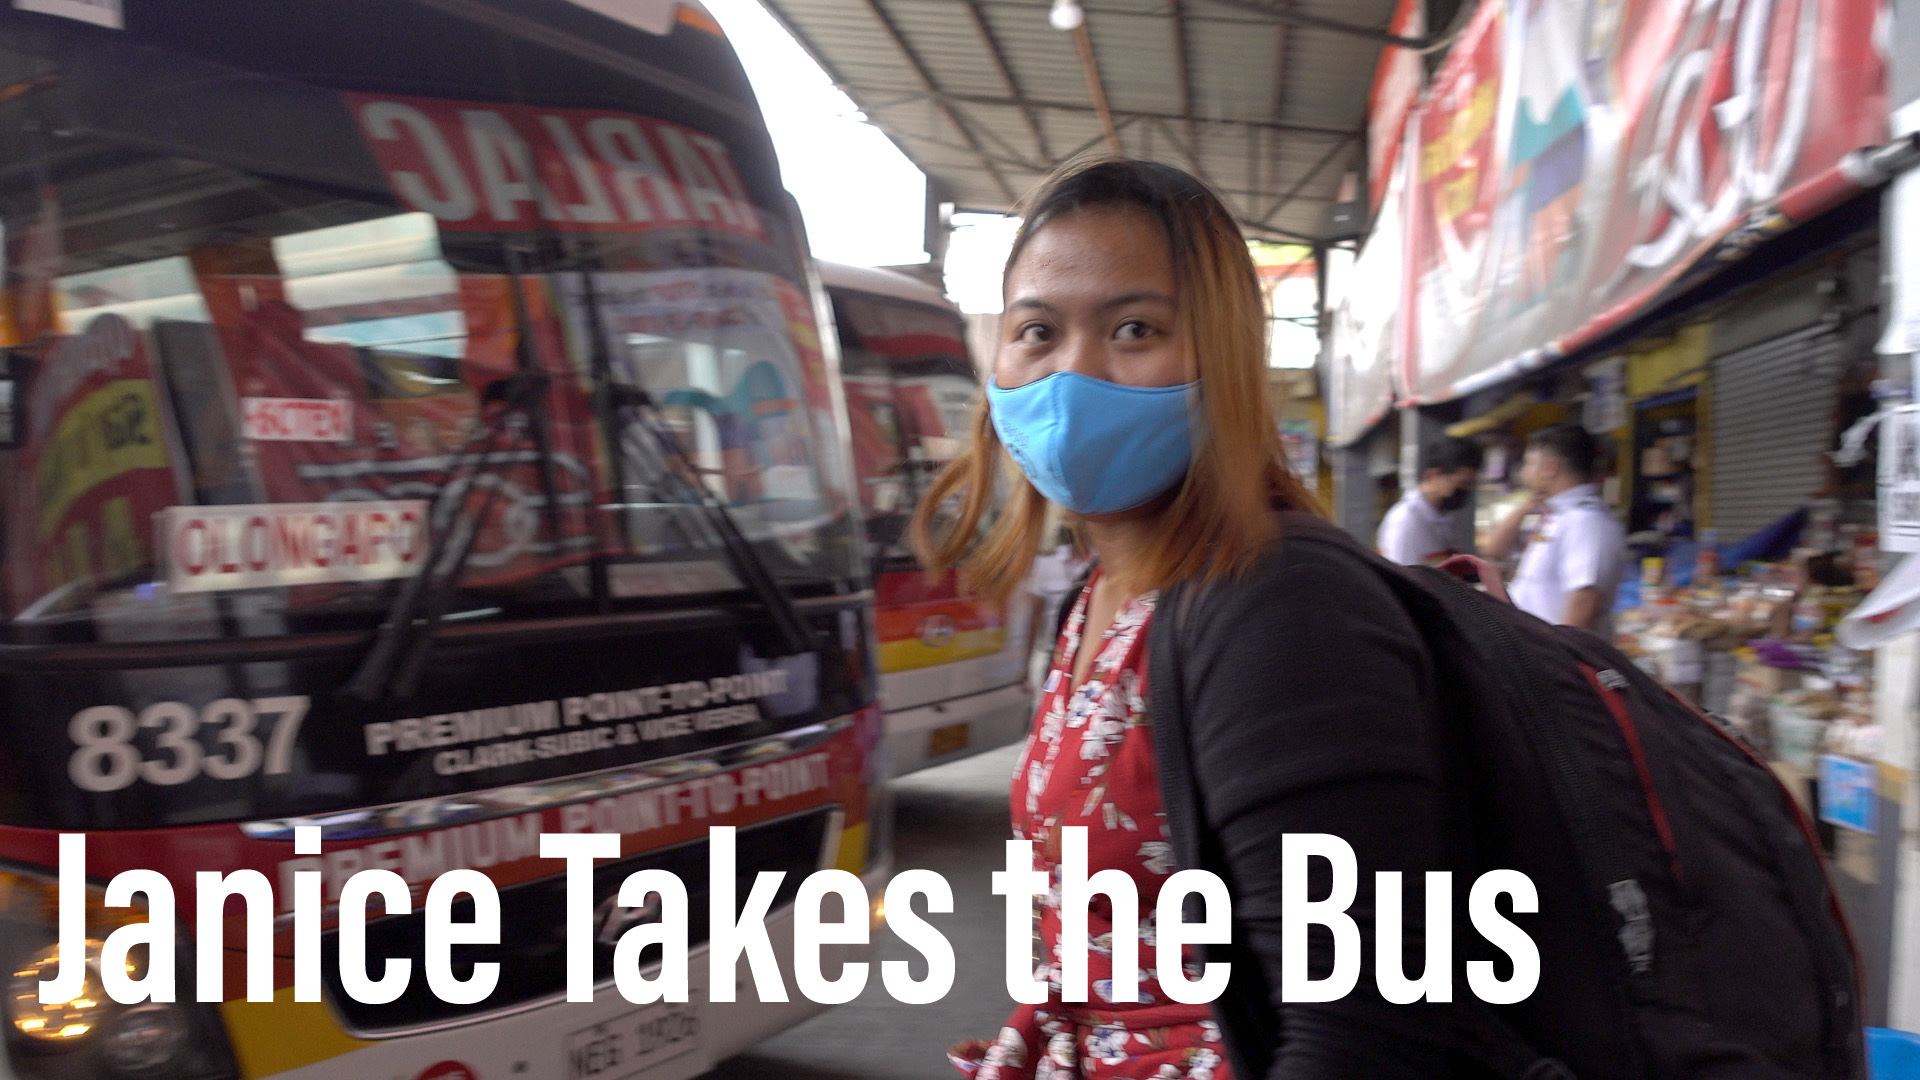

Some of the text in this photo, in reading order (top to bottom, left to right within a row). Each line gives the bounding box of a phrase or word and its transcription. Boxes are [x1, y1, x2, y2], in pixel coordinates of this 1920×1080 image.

[176, 510, 428, 576] OLONGAPO
[67, 694, 311, 793] 8337
[363, 668, 789, 756] PREMIUM POINT-TO-POINT
[636, 711, 695, 742] VICE
